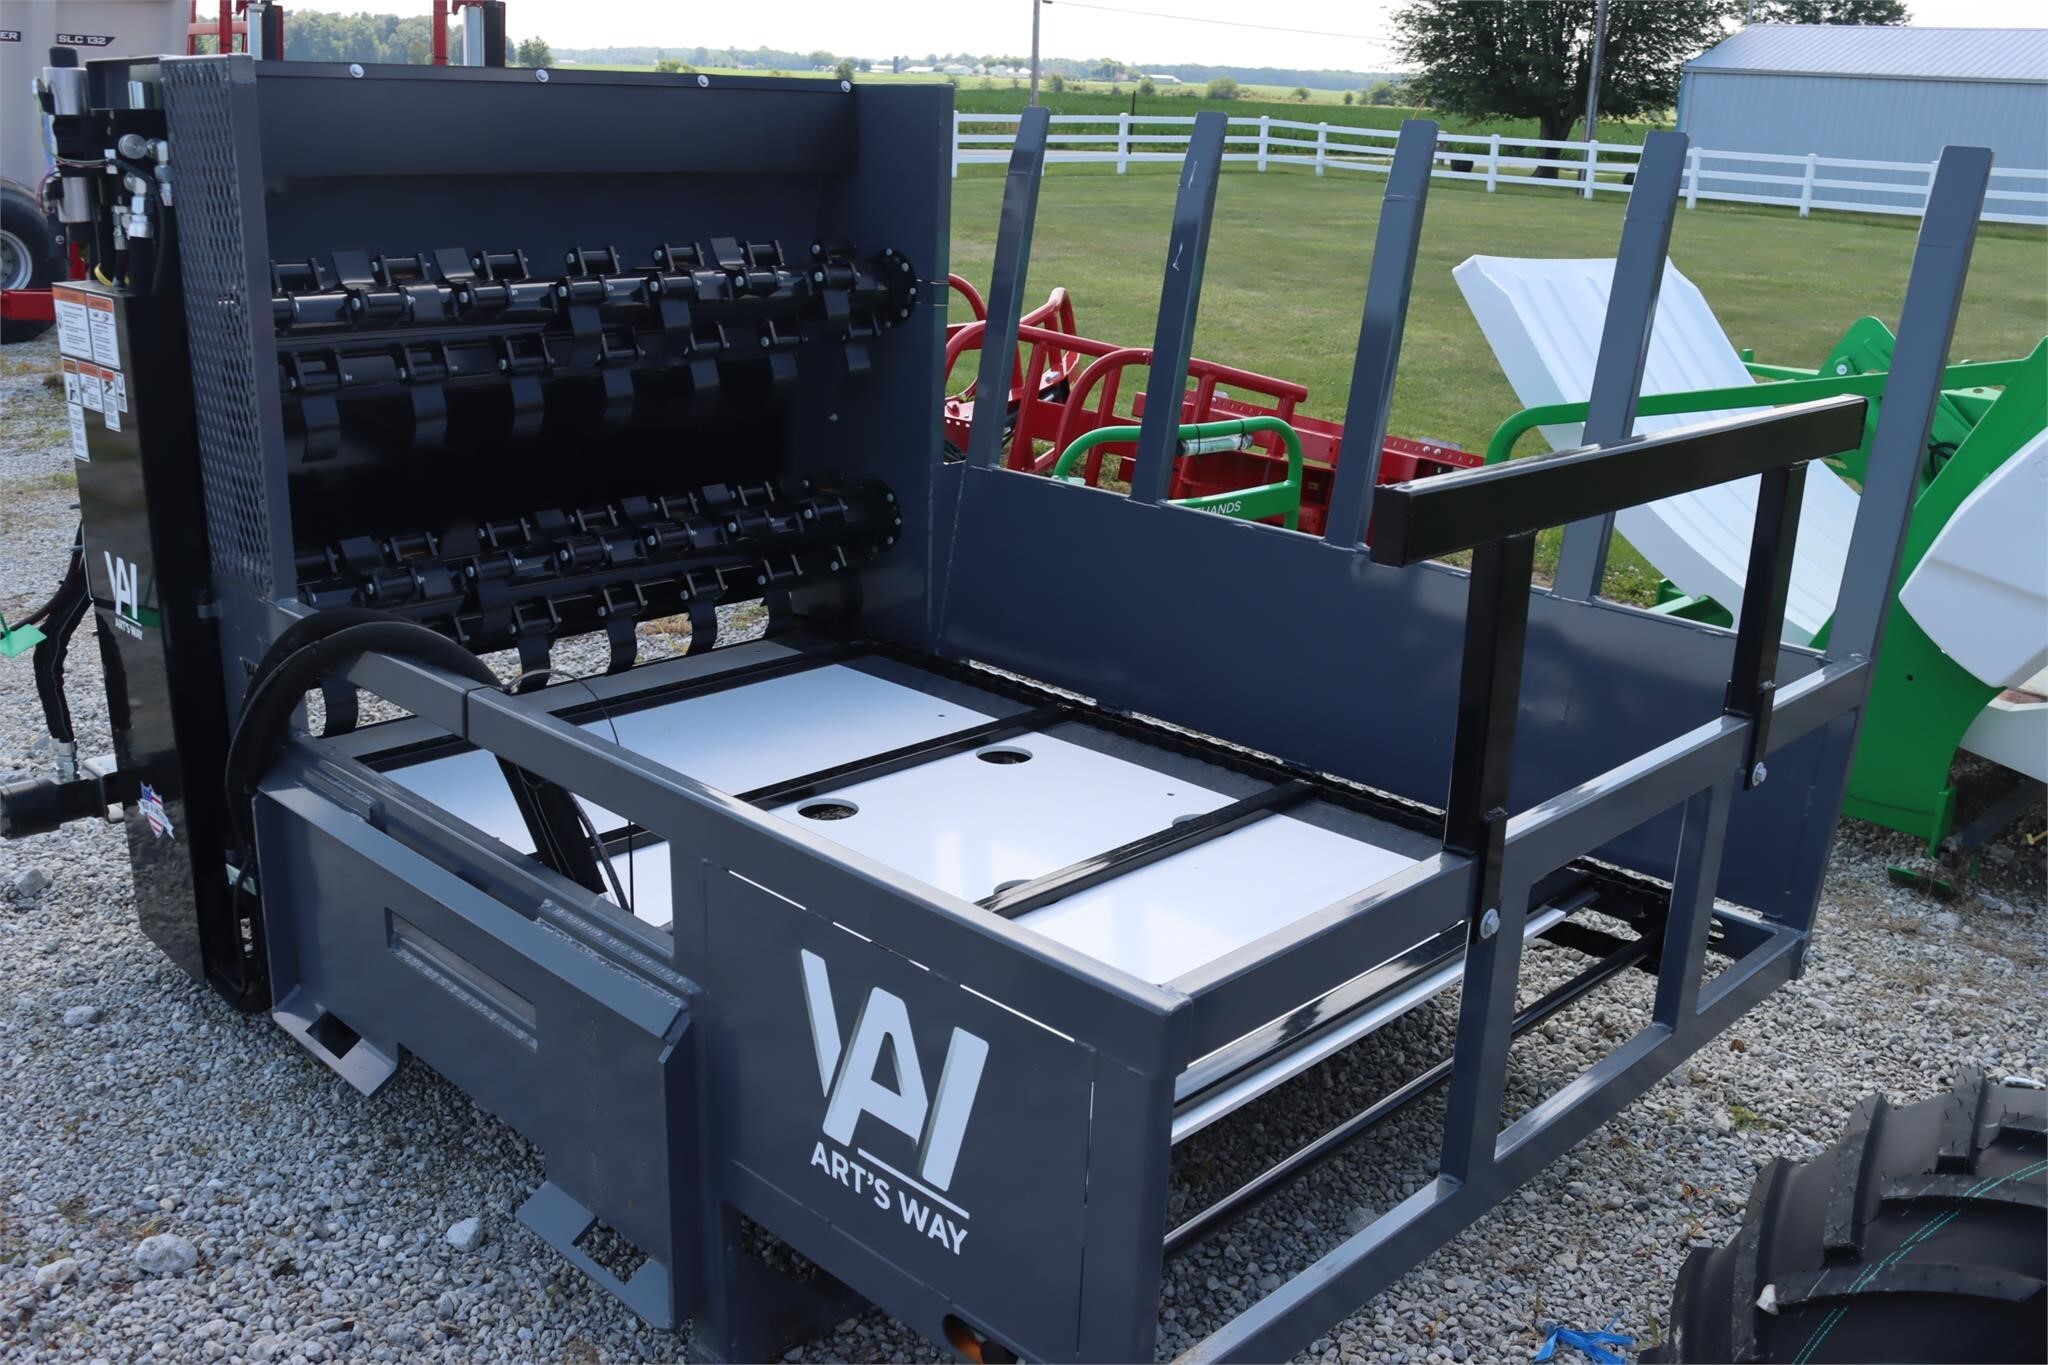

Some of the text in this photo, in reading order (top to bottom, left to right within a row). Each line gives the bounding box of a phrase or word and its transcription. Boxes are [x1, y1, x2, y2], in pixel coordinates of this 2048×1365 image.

[58, 35, 106, 45] SLC 132
[810, 1141, 968, 1256] ART'S WAY
